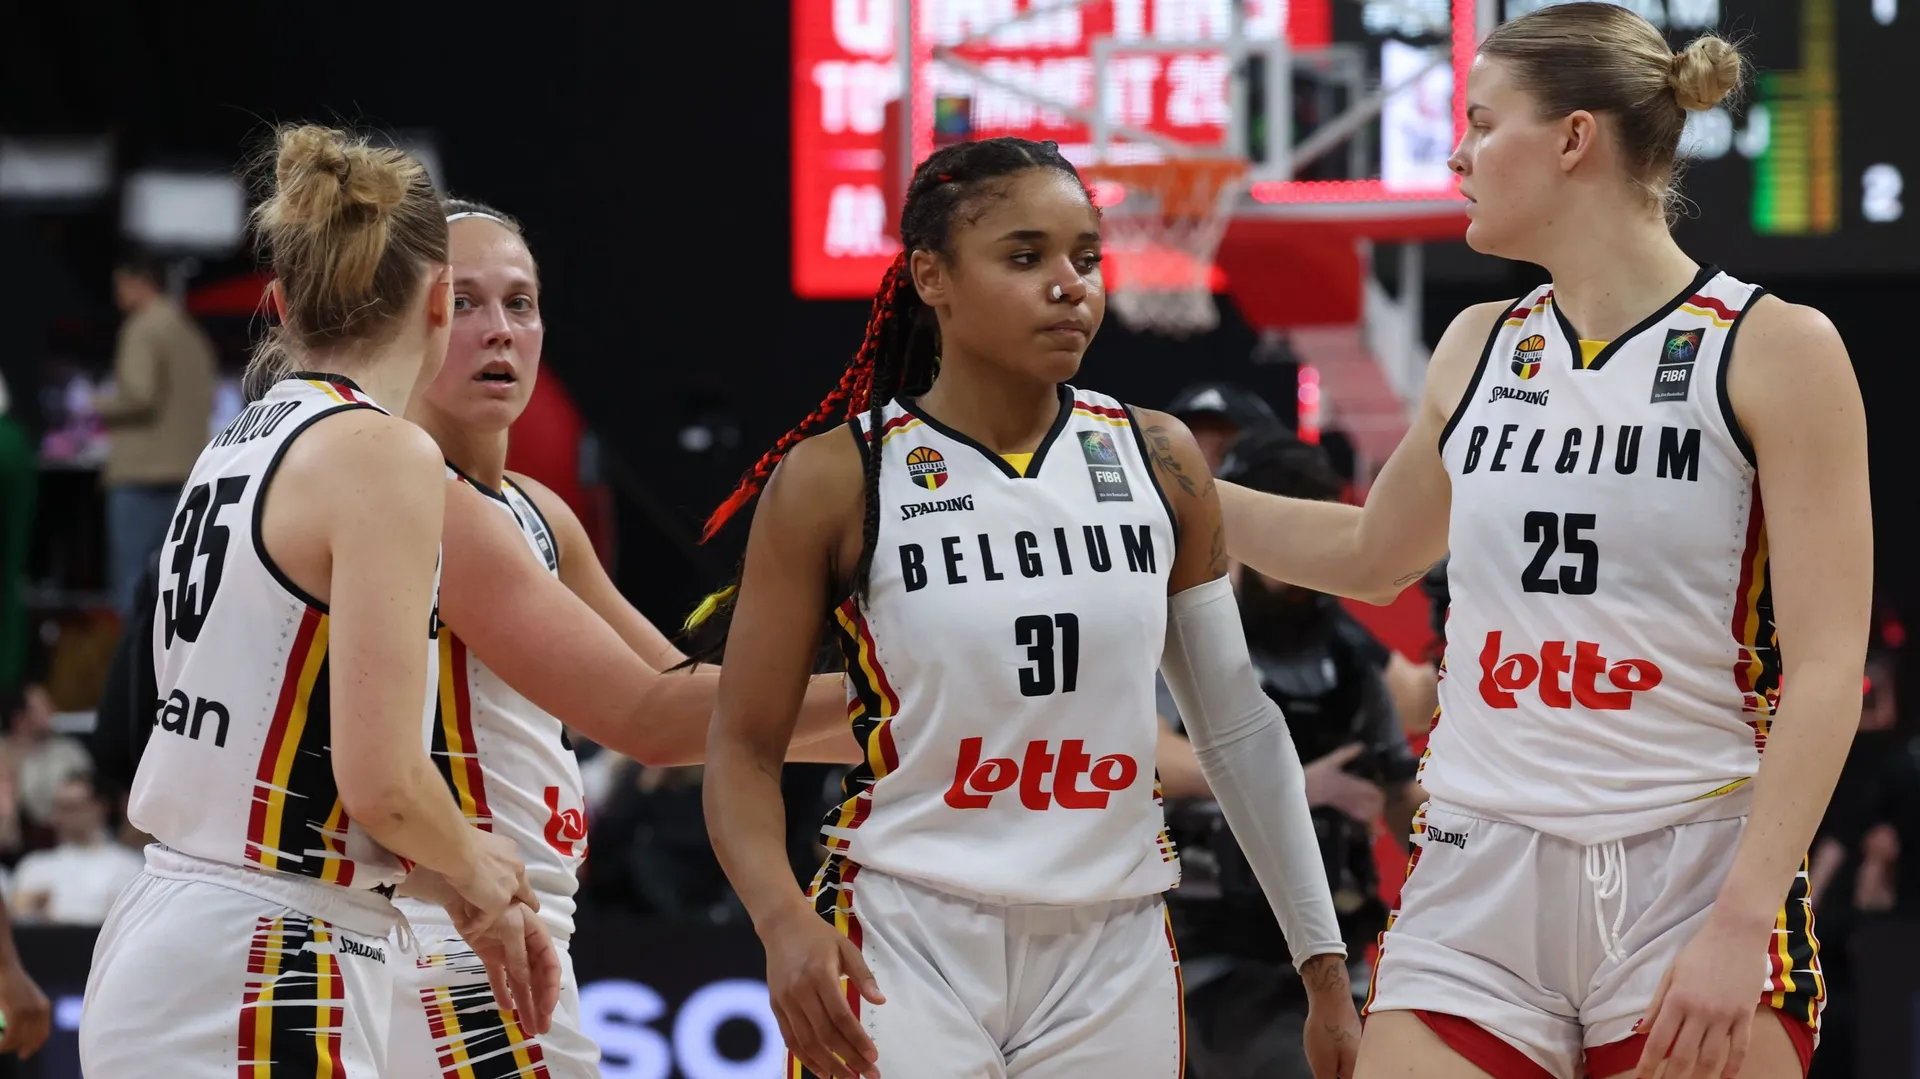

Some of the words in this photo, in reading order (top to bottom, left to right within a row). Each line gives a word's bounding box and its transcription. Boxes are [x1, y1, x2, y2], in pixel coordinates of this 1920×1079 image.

[1488, 385, 1550, 406] SPALDING
[1659, 368, 1687, 383] FIBA
[1095, 470, 1122, 483] FIBA
[1462, 424, 1702, 482] BELGIUM
[900, 494, 974, 521] SPALDING
[162, 475, 251, 650] 35
[898, 524, 1157, 592] BELGIUM
[1521, 510, 1599, 596] 25
[1014, 612, 1079, 697] 31
